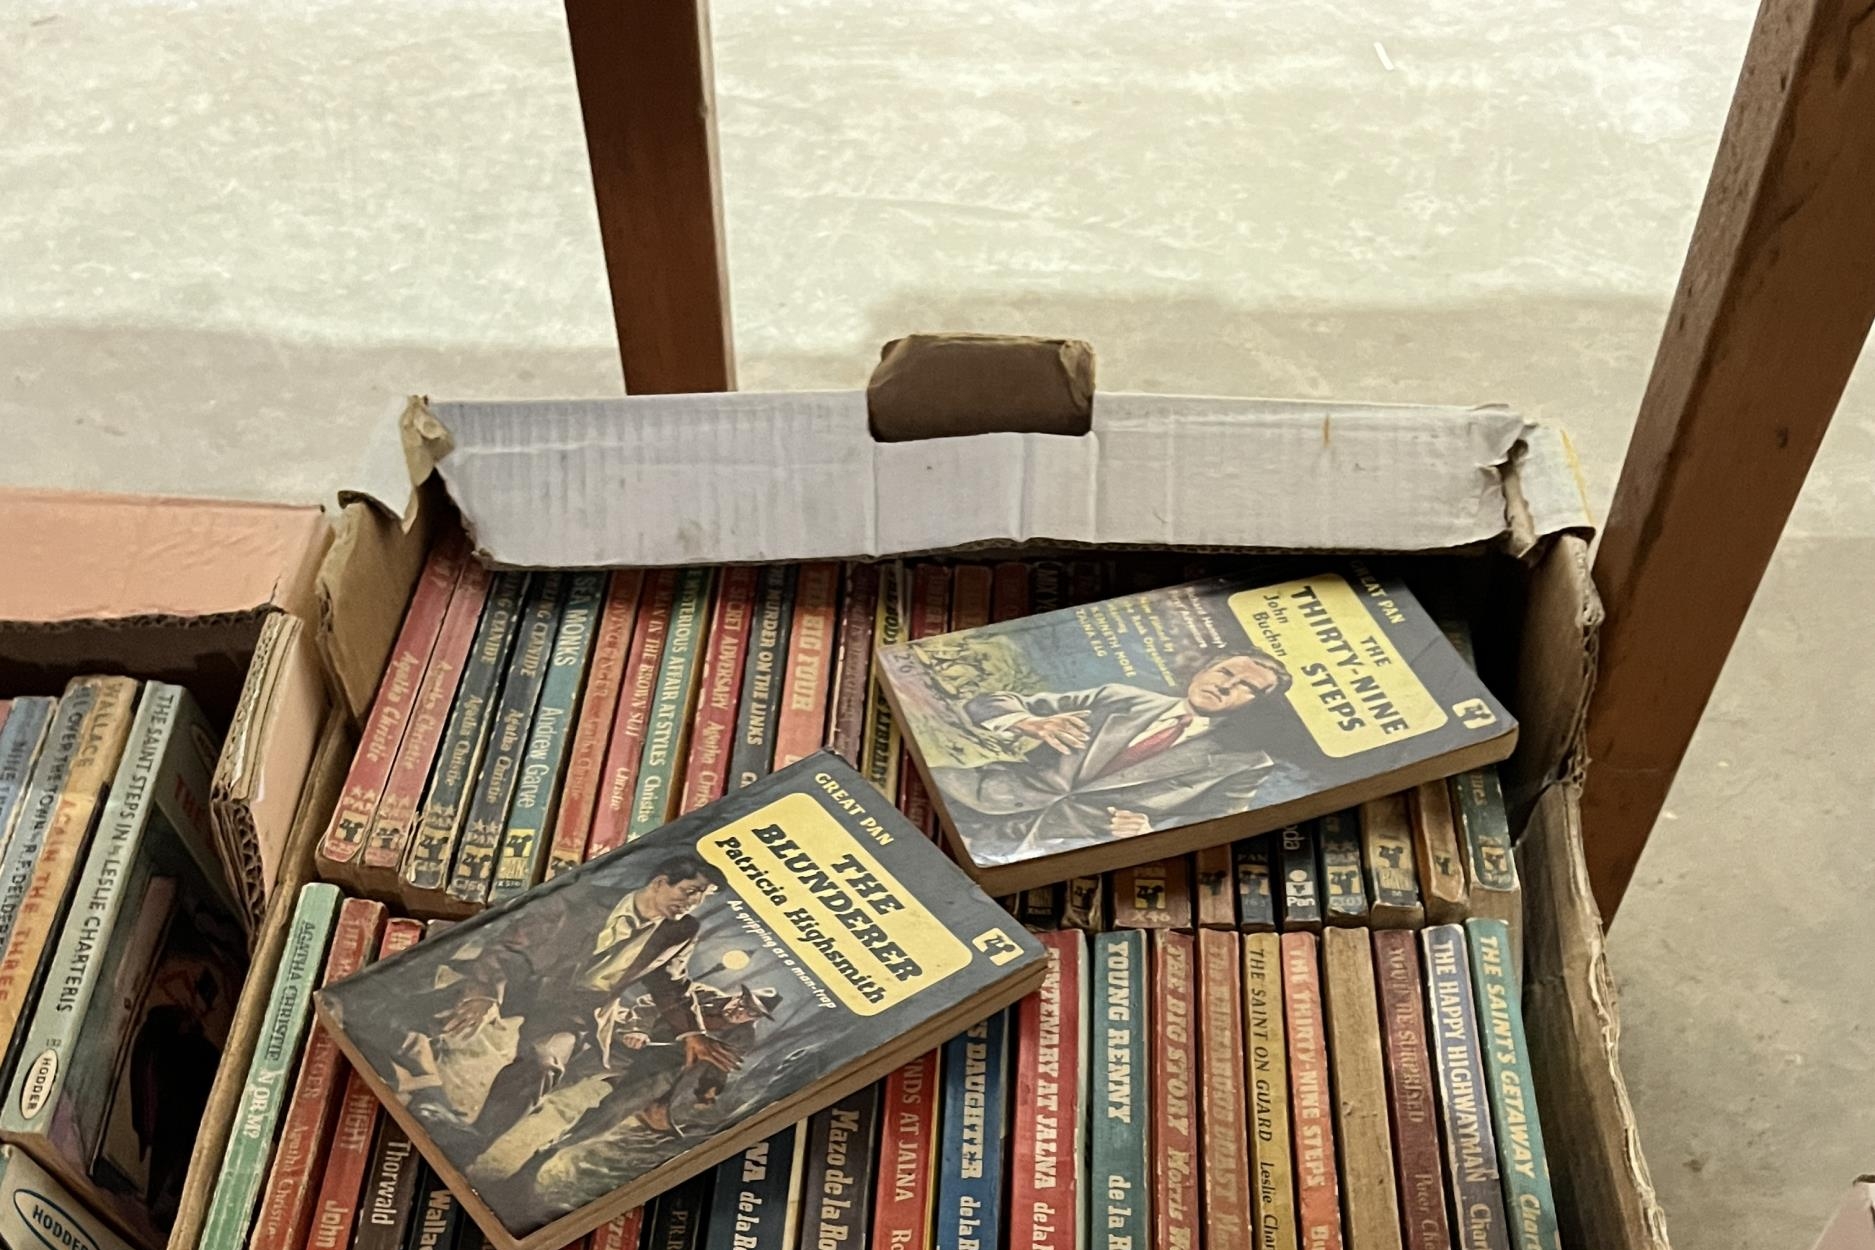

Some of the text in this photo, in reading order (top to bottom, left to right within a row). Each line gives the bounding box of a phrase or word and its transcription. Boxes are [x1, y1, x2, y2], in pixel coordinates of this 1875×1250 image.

[1091, 607, 1137, 678] KENNETH MORE
[1252, 595, 1288, 657] John Buchan
[1379, 600, 1405, 625] PAN
[712, 638, 739, 710] ADVERSARY
[1290, 585, 1409, 735] THE THIRTY-NINE STEPS
[517, 609, 589, 809] MONKS Andrew Garve
[814, 772, 894, 846] GREAT PAN
[57, 695, 173, 1013] THE SAINT STEPS IN LESLIE CHARTERIS
[715, 836, 888, 1005] Patricia Highsmith
[751, 824, 924, 983] THE BLUNDERER
[727, 900, 837, 1009] As gripping as a man-trap
[1107, 940, 1130, 1021] YOUNG
[1250, 949, 1265, 981] THE
[1433, 940, 1456, 975] THE
[1480, 936, 1499, 976] THE
[264, 921, 316, 1061] AGATHA CHRISTIE
[1252, 989, 1267, 1041] SAINT
[1438, 981, 1466, 1042] HAPPY
[1486, 985, 1516, 1065] SAINT'S
[28, 1057, 52, 1110] HODDER
[1107, 1029, 1131, 1124] RENNY
[1254, 1047, 1269, 1071] ON
[826, 1108, 859, 1167] Mazo
[900, 1112, 919, 1139] AT
[1256, 1079, 1272, 1142] GUARD
[1448, 1046, 1486, 1183] HIGHWAYMAN
[1501, 1070, 1535, 1180] GETAWAY
[372, 1140, 410, 1226] Thorwald
[824, 1166, 854, 1195] de
[894, 1142, 917, 1203] JALNA
[1108, 1175, 1131, 1200] de
[1260, 1161, 1276, 1204] Leslie
[319, 1200, 348, 1249] John
[820, 1200, 851, 1222] la
[1107, 1206, 1131, 1228] la
